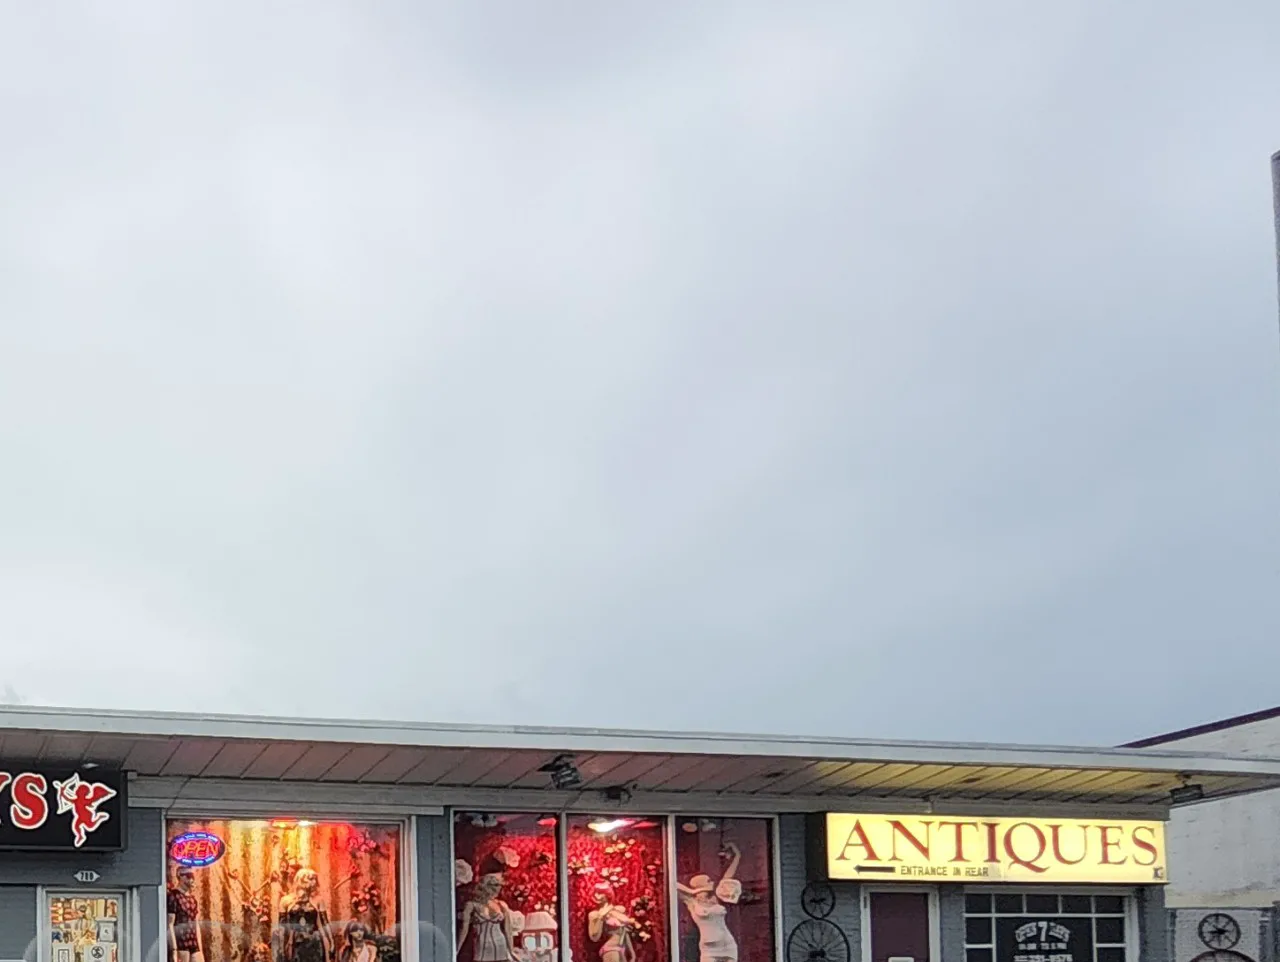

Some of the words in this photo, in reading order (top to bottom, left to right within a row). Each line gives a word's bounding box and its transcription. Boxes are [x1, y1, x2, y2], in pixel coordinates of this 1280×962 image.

[170, 840, 220, 858] OPEN
[835, 819, 1158, 873] ANTIQUES
[900, 865, 948, 877] ENTRANCE
[952, 866, 962, 877] IN
[965, 867, 990, 878] REAR
[1038, 921, 1048, 942] 7
